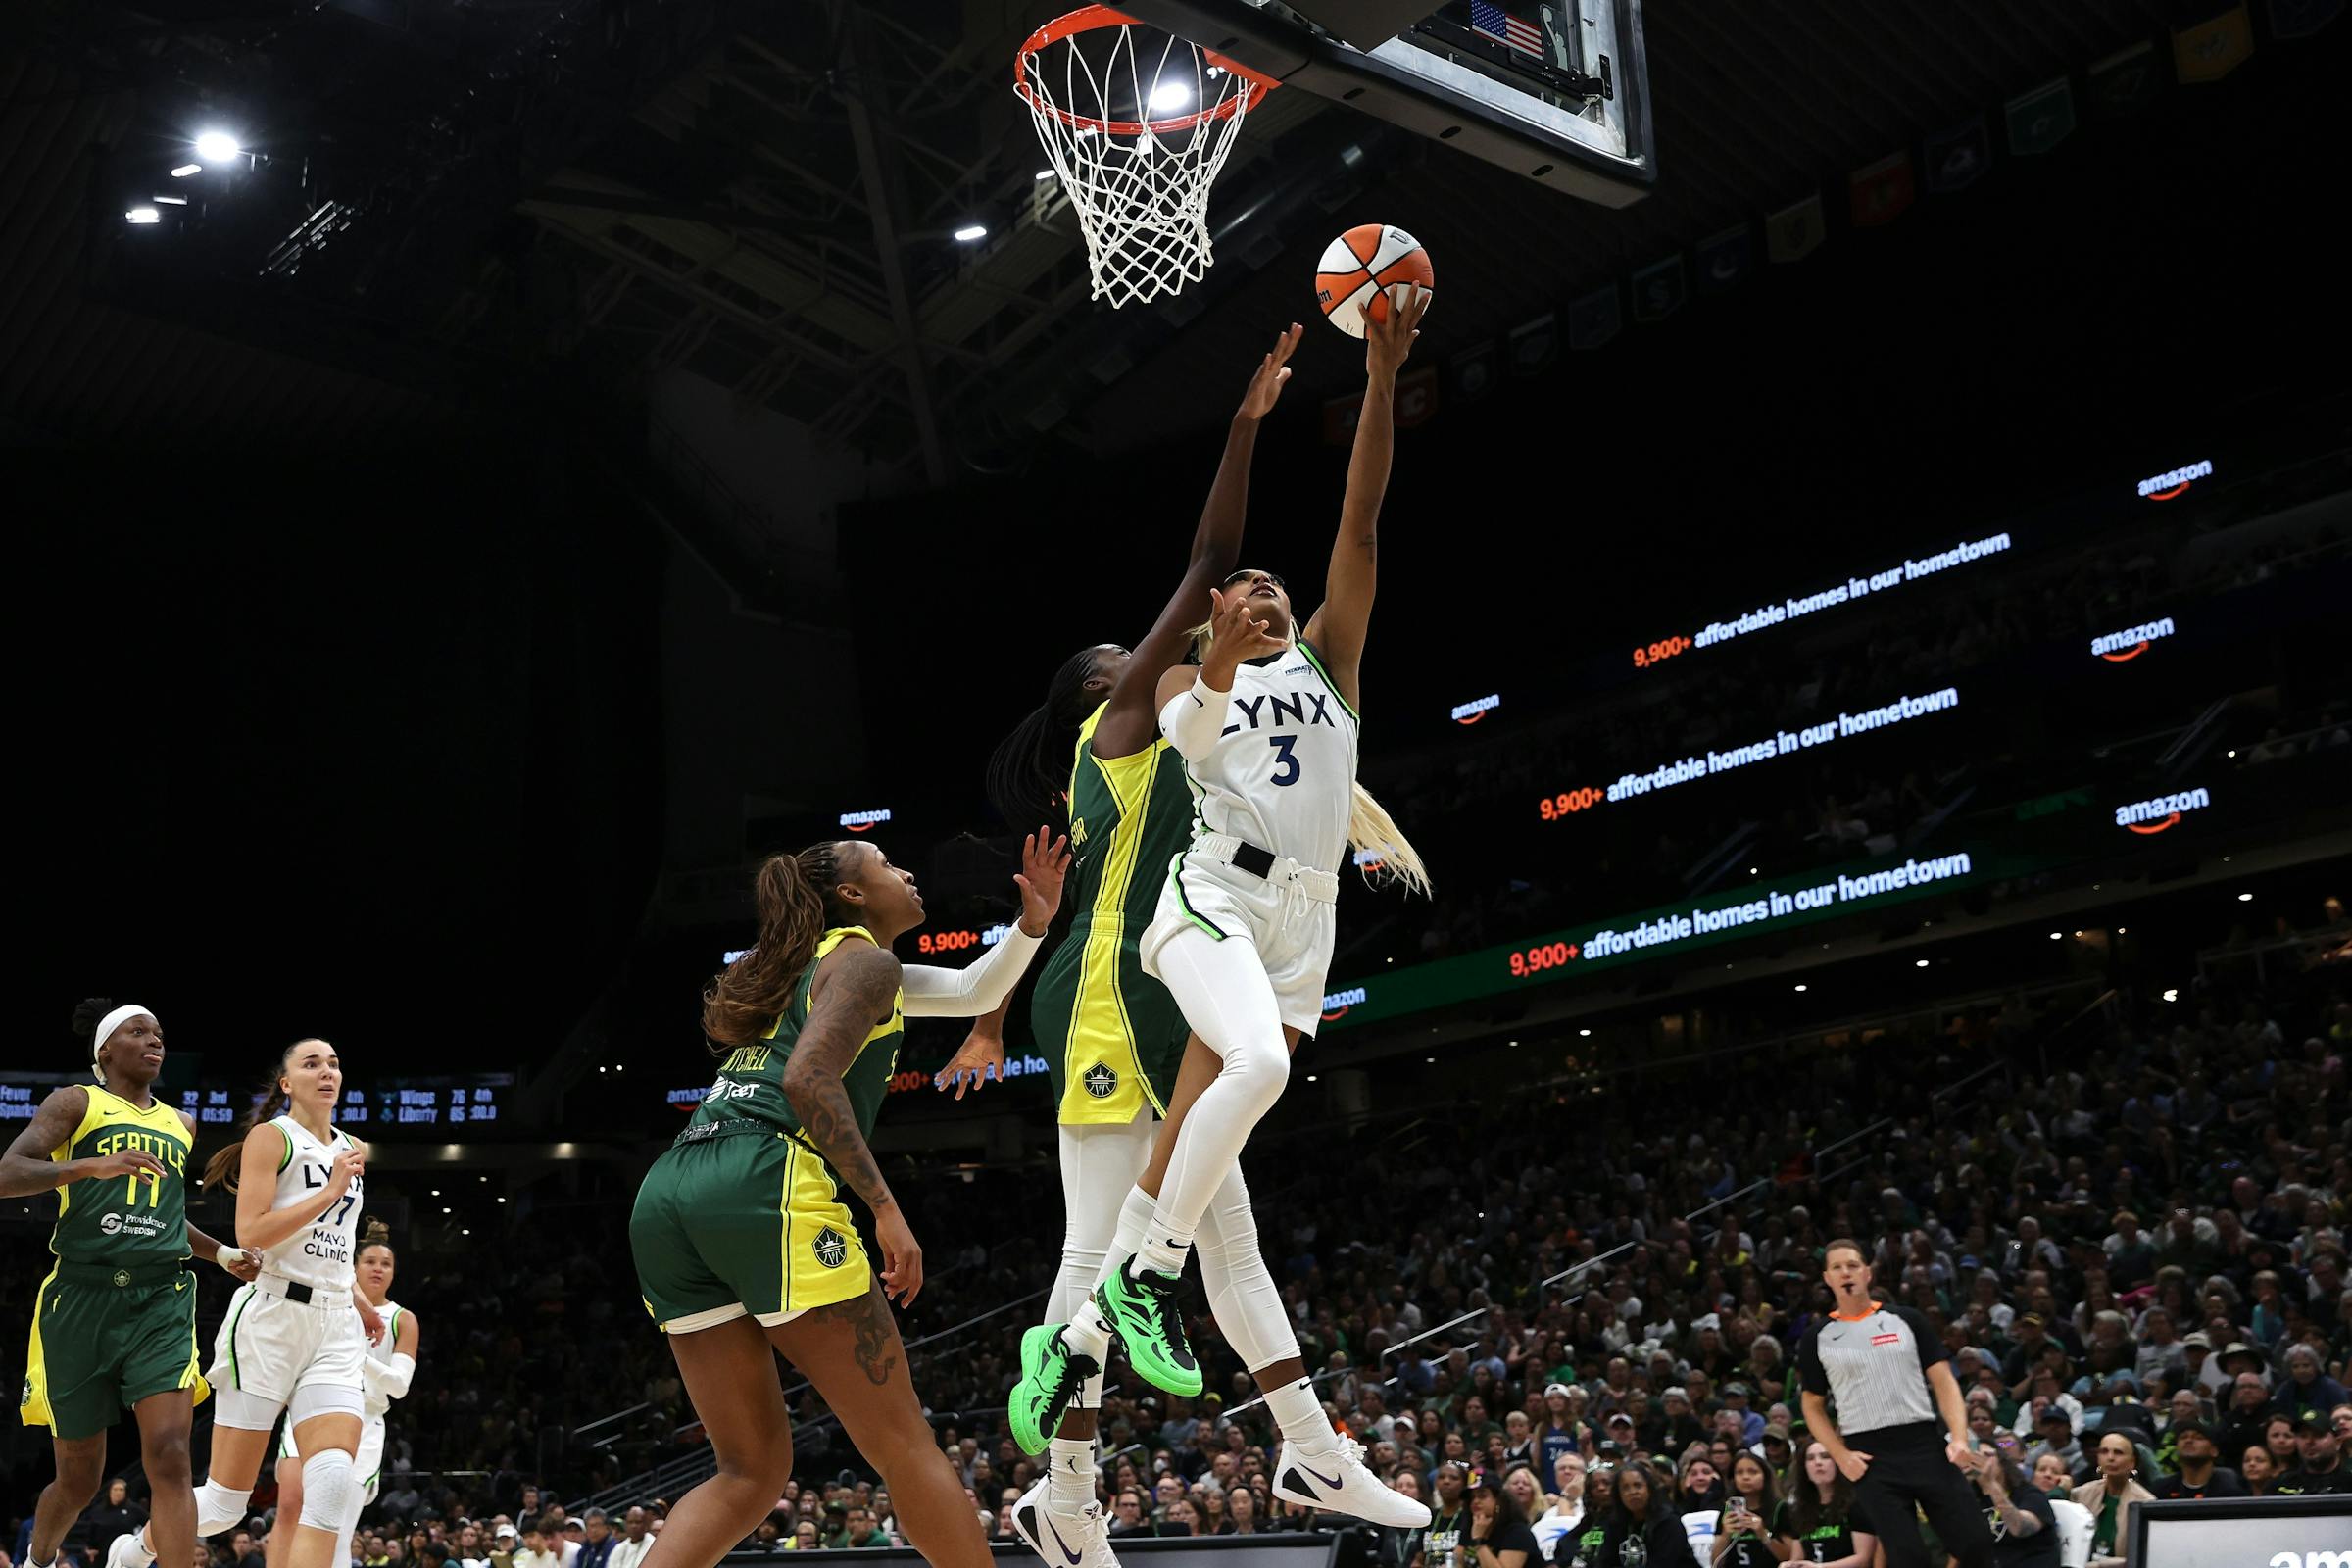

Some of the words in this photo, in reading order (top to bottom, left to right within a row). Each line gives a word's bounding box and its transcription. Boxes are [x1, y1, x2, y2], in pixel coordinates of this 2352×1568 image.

[2137, 460, 2213, 496] amazon
[1634, 635, 1691, 667] 9,900+
[1694, 604, 1786, 649] affordable
[1786, 584, 1849, 619] homes
[1848, 576, 1869, 599] in
[1869, 565, 1904, 591] our
[1904, 532, 2011, 581] hometown
[2090, 616, 2175, 657] amazon
[1451, 694, 1499, 720] amazon
[1269, 735, 1301, 787] 3
[1539, 786, 1604, 821] 9,900+
[1607, 756, 1707, 803] affordable
[1707, 738, 1778, 774] homes
[1777, 731, 1799, 754] in
[1799, 719, 1838, 748] our
[1838, 686, 1959, 738] hometown
[840, 809, 891, 826] amazon
[2115, 787, 2210, 826] amazon
[1509, 941, 1580, 978] 9,900+
[1583, 909, 1692, 960] affordable
[1693, 896, 1769, 935] homes
[1768, 891, 1793, 918] in
[1794, 880, 1838, 911] our
[1838, 852, 1970, 904] hometown
[918, 930, 979, 955] 9,900+
[398, 1107, 438, 1123] Liberty
[400, 1090, 435, 1105] Wings
[97, 1131, 186, 1179] SEATTLE
[122, 1225, 156, 1237] SWEDISH
[125, 1214, 167, 1230] Providence
